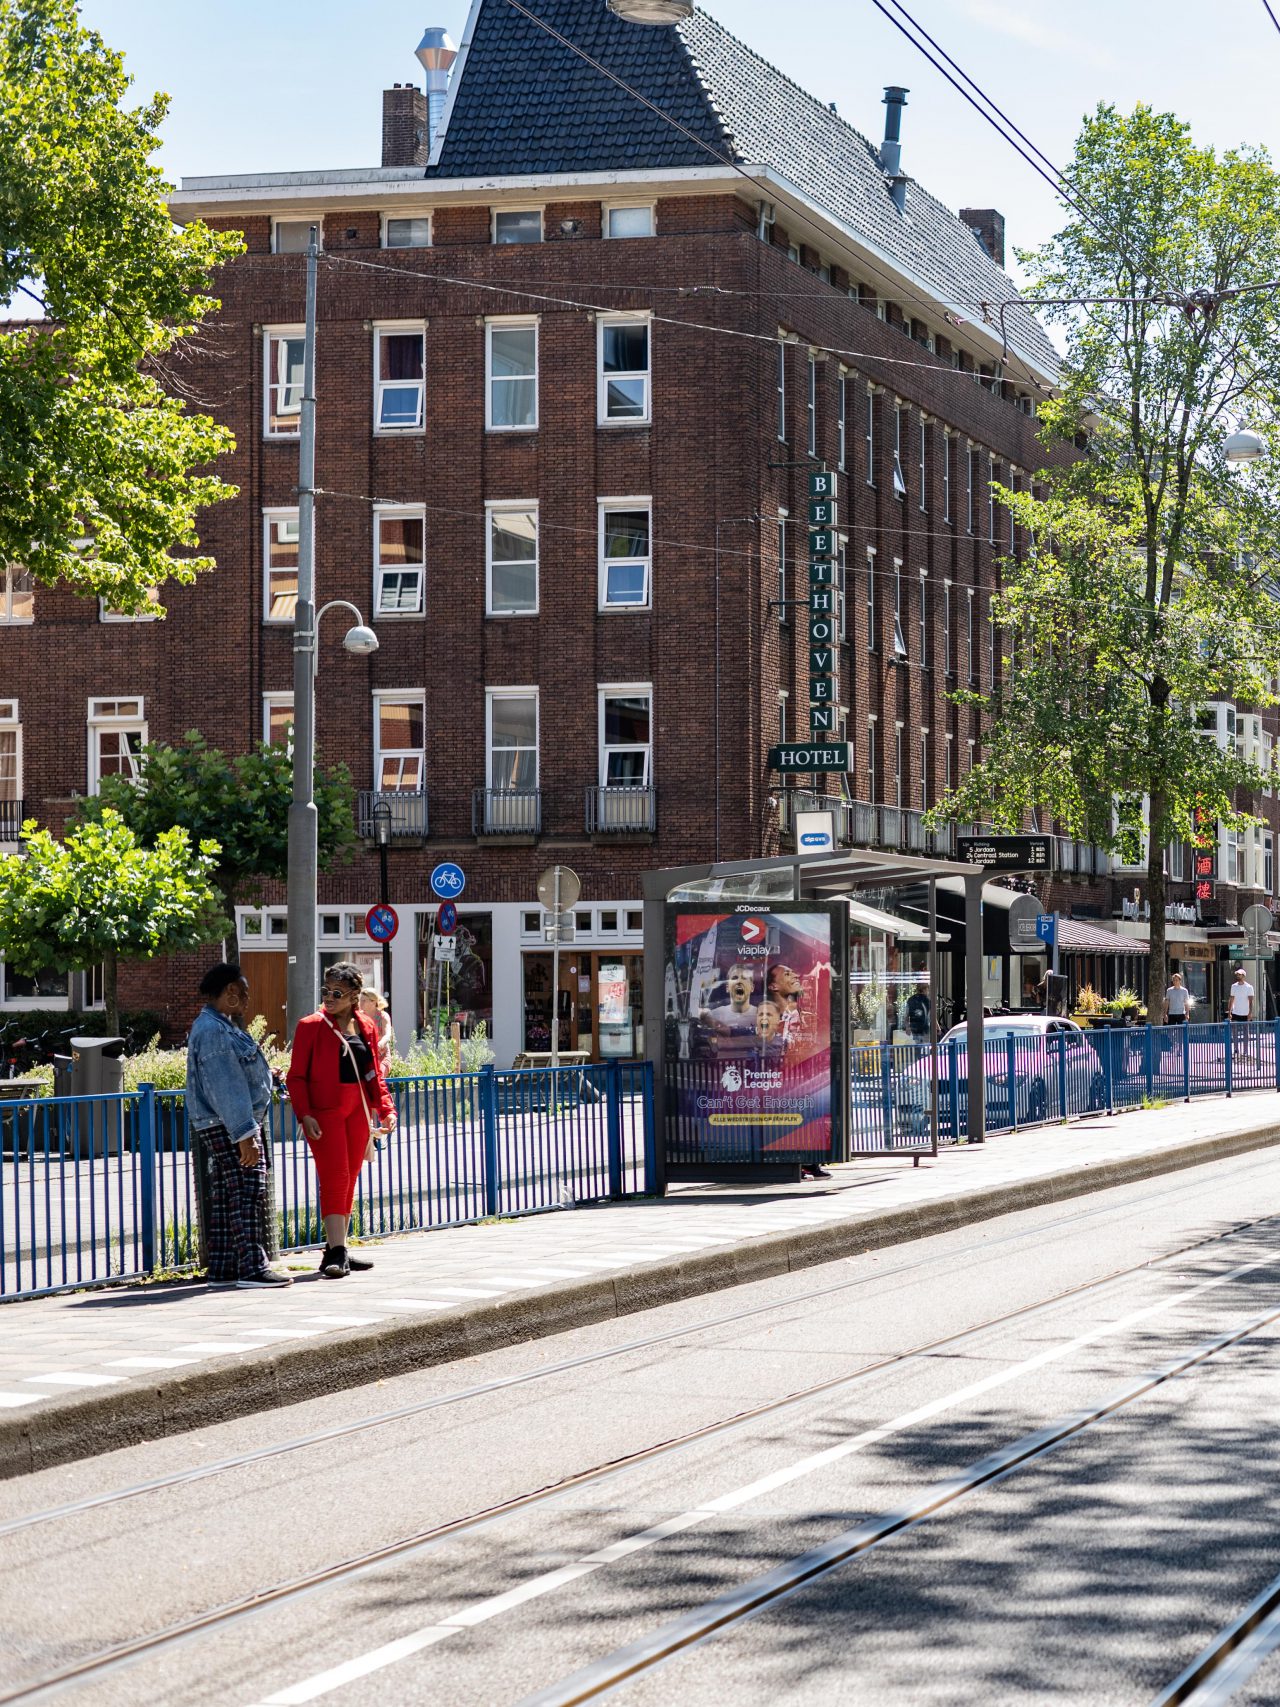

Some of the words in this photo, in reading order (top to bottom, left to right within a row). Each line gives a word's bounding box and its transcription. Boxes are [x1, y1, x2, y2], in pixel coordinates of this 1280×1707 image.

[813, 477, 829, 730] BEETHOVEN
[780, 750, 845, 765] HOTEL
[1041, 923, 1049, 935] P
[737, 945, 771, 956] viaplay
[744, 1069, 782, 1079] Premier
[744, 1081, 782, 1090] League
[697, 1096, 733, 1108] Can't
[735, 1096, 760, 1108] Get
[763, 1095, 814, 1110] Enough
